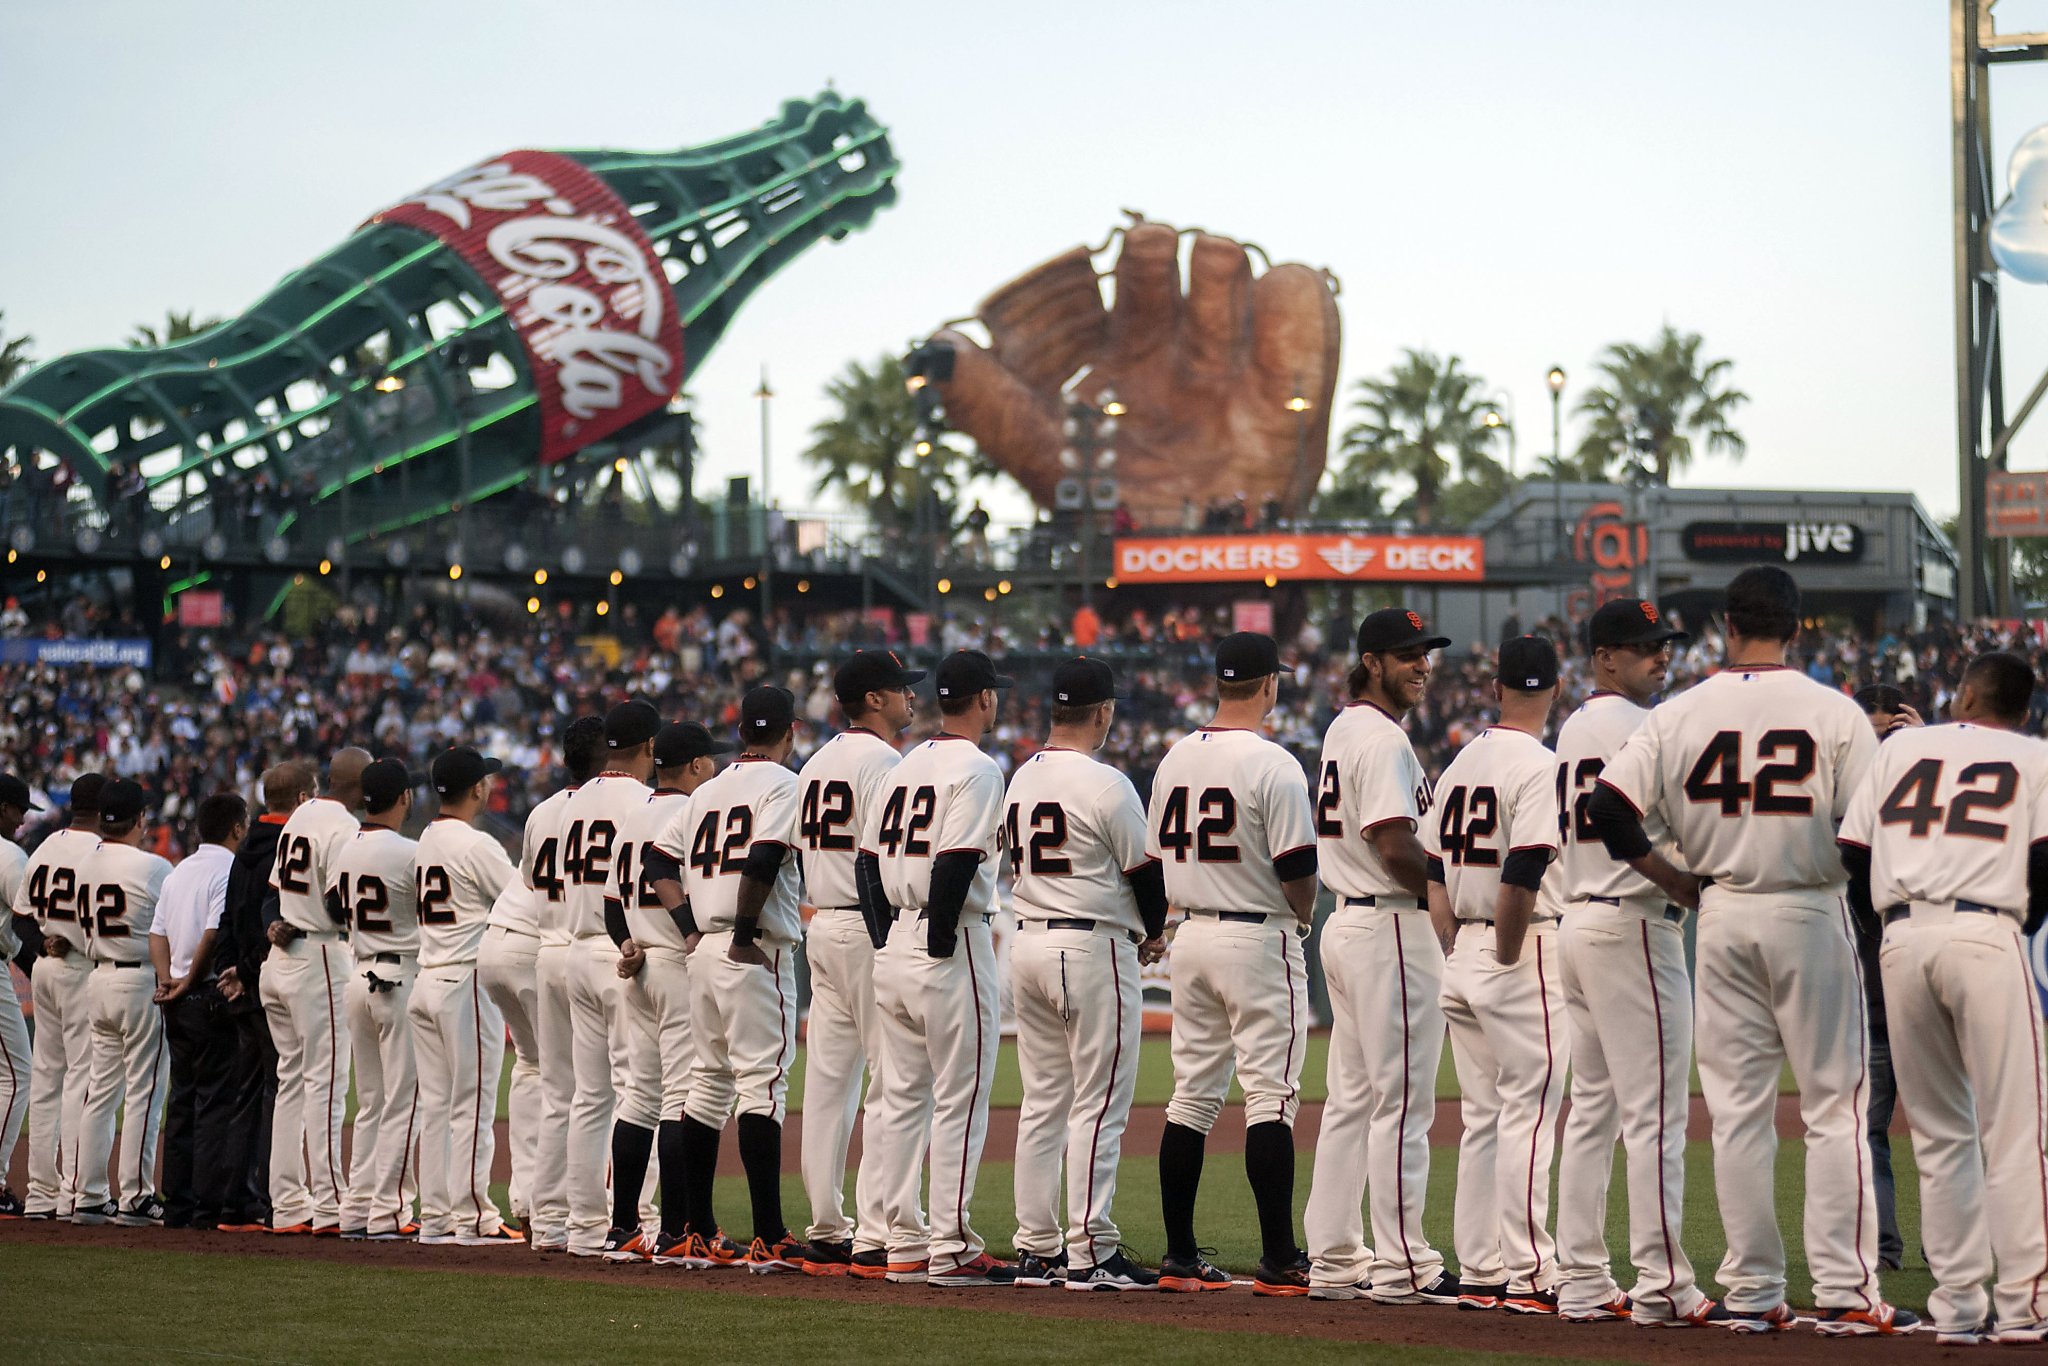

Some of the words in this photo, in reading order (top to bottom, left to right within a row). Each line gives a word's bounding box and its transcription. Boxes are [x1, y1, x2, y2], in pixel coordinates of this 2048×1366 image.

[1121, 543, 1299, 573] DOCKERS
[1384, 545, 1475, 570] DECK
[1784, 522, 1854, 562] jive
[1316, 760, 1343, 838] 2
[1683, 729, 1817, 818] 42
[1879, 759, 2020, 844] 42
[690, 805, 754, 879] 42
[801, 780, 854, 851] 42
[879, 785, 936, 857] 42
[1005, 801, 1072, 876] 42
[1158, 786, 1241, 863] 42
[1440, 785, 1500, 867] 42
[532, 837, 566, 903] 4
[564, 820, 617, 885] 42
[29, 864, 76, 921] 42
[77, 884, 130, 938] 42
